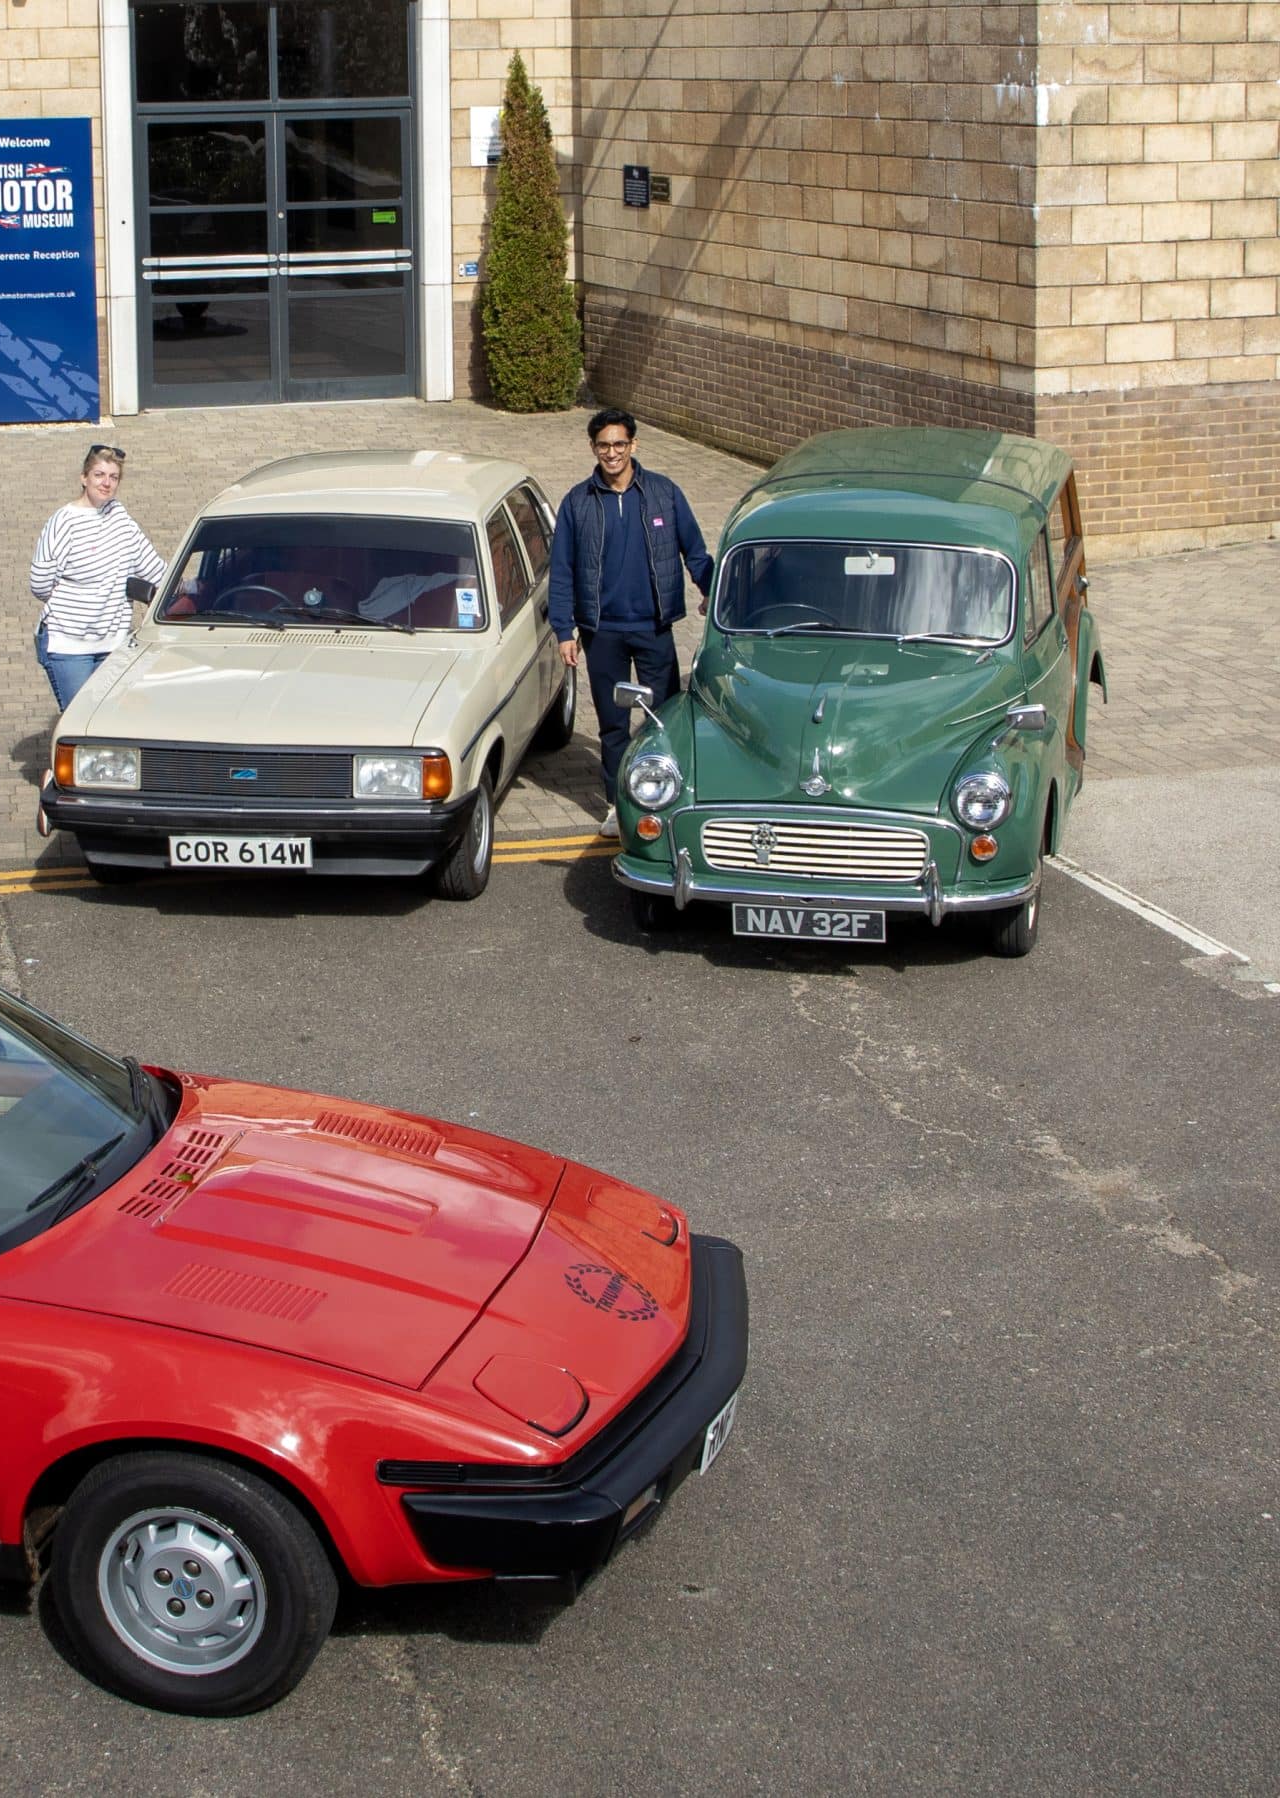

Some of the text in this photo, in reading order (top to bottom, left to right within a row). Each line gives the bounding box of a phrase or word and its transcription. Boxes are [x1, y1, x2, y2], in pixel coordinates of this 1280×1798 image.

[23, 213, 74, 228] MUSEUM
[33, 250, 80, 260] Reception
[176, 841, 305, 864] COR 614W
[747, 908, 870, 937] NAV 32F
